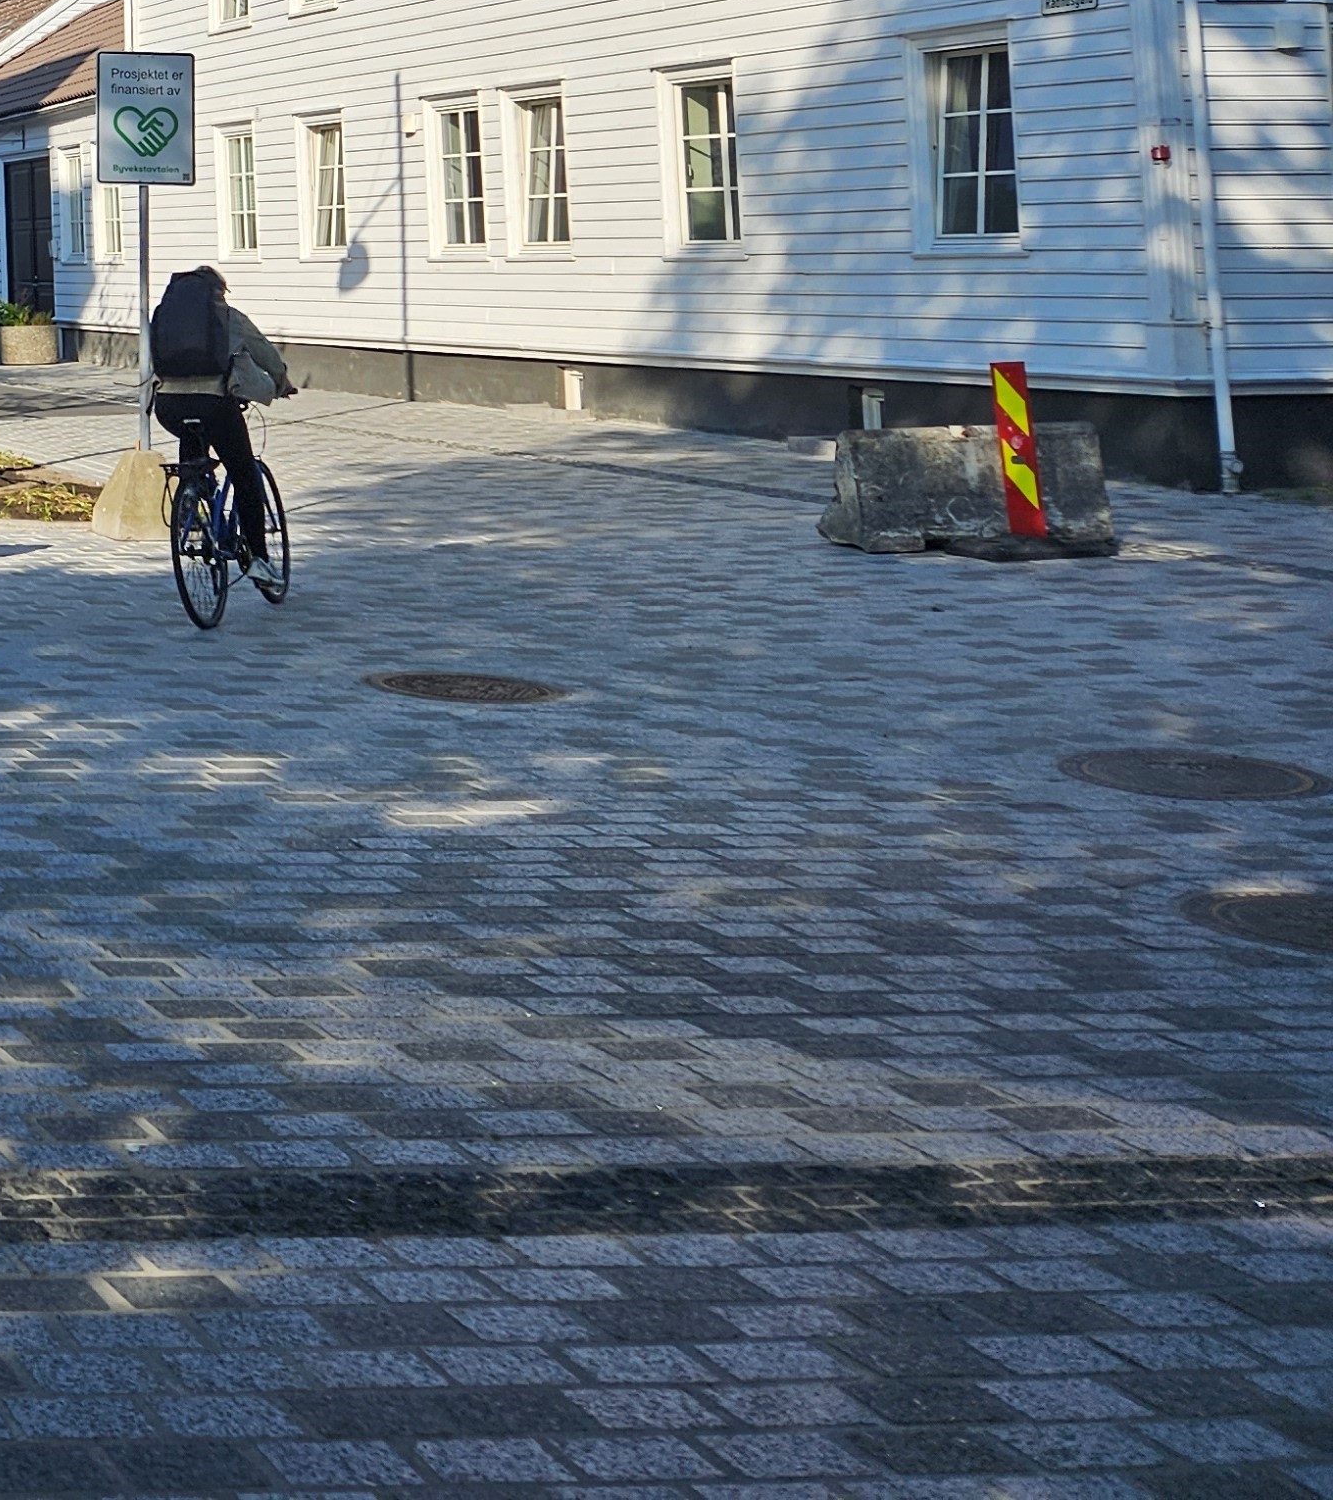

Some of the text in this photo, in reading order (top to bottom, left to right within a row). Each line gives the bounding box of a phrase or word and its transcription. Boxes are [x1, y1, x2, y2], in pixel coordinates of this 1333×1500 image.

[111, 68, 184, 82] Prosjektet er
[111, 83, 181, 96] finansiert av
[113, 164, 180, 174] Byvekstavtalen
